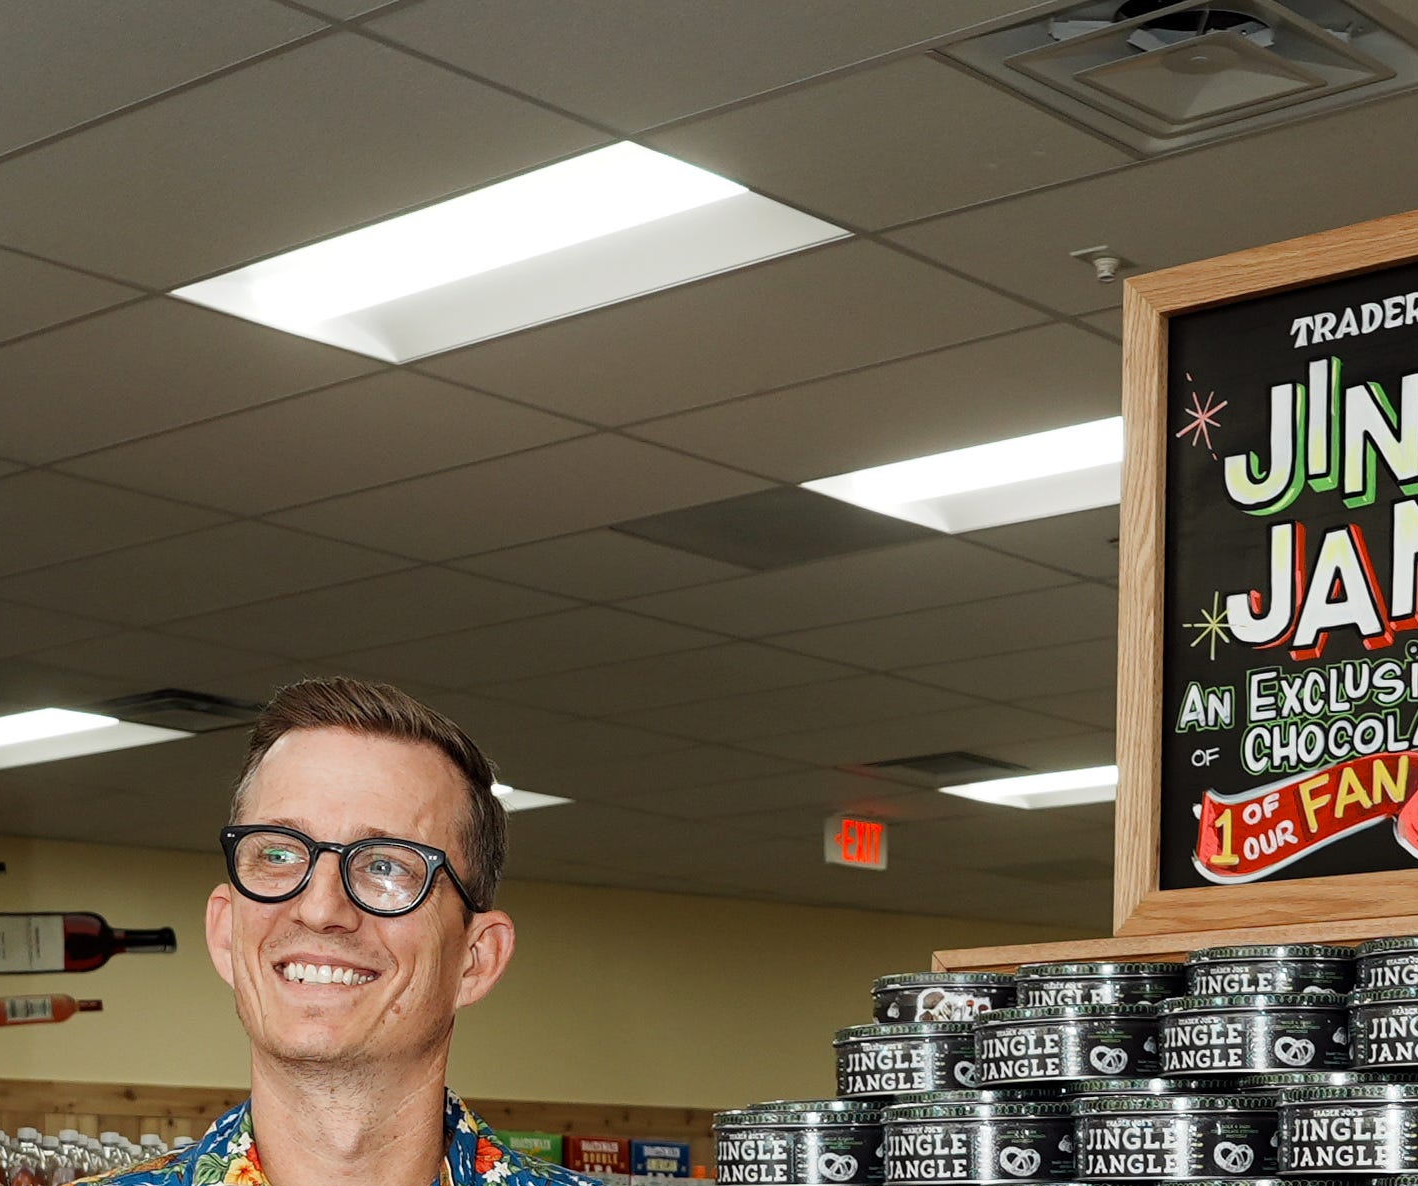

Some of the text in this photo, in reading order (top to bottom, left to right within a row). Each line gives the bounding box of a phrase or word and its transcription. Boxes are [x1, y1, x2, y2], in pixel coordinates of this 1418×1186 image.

[1180, 684, 1232, 730] AN
[1242, 794, 1280, 826] OF
[1298, 756, 1411, 833] FAN
[842, 819, 884, 865] EXIT
[1244, 819, 1298, 861] OUR
[981, 1033, 1060, 1058] JINGLE
[980, 1057, 1061, 1082] JANGLE
